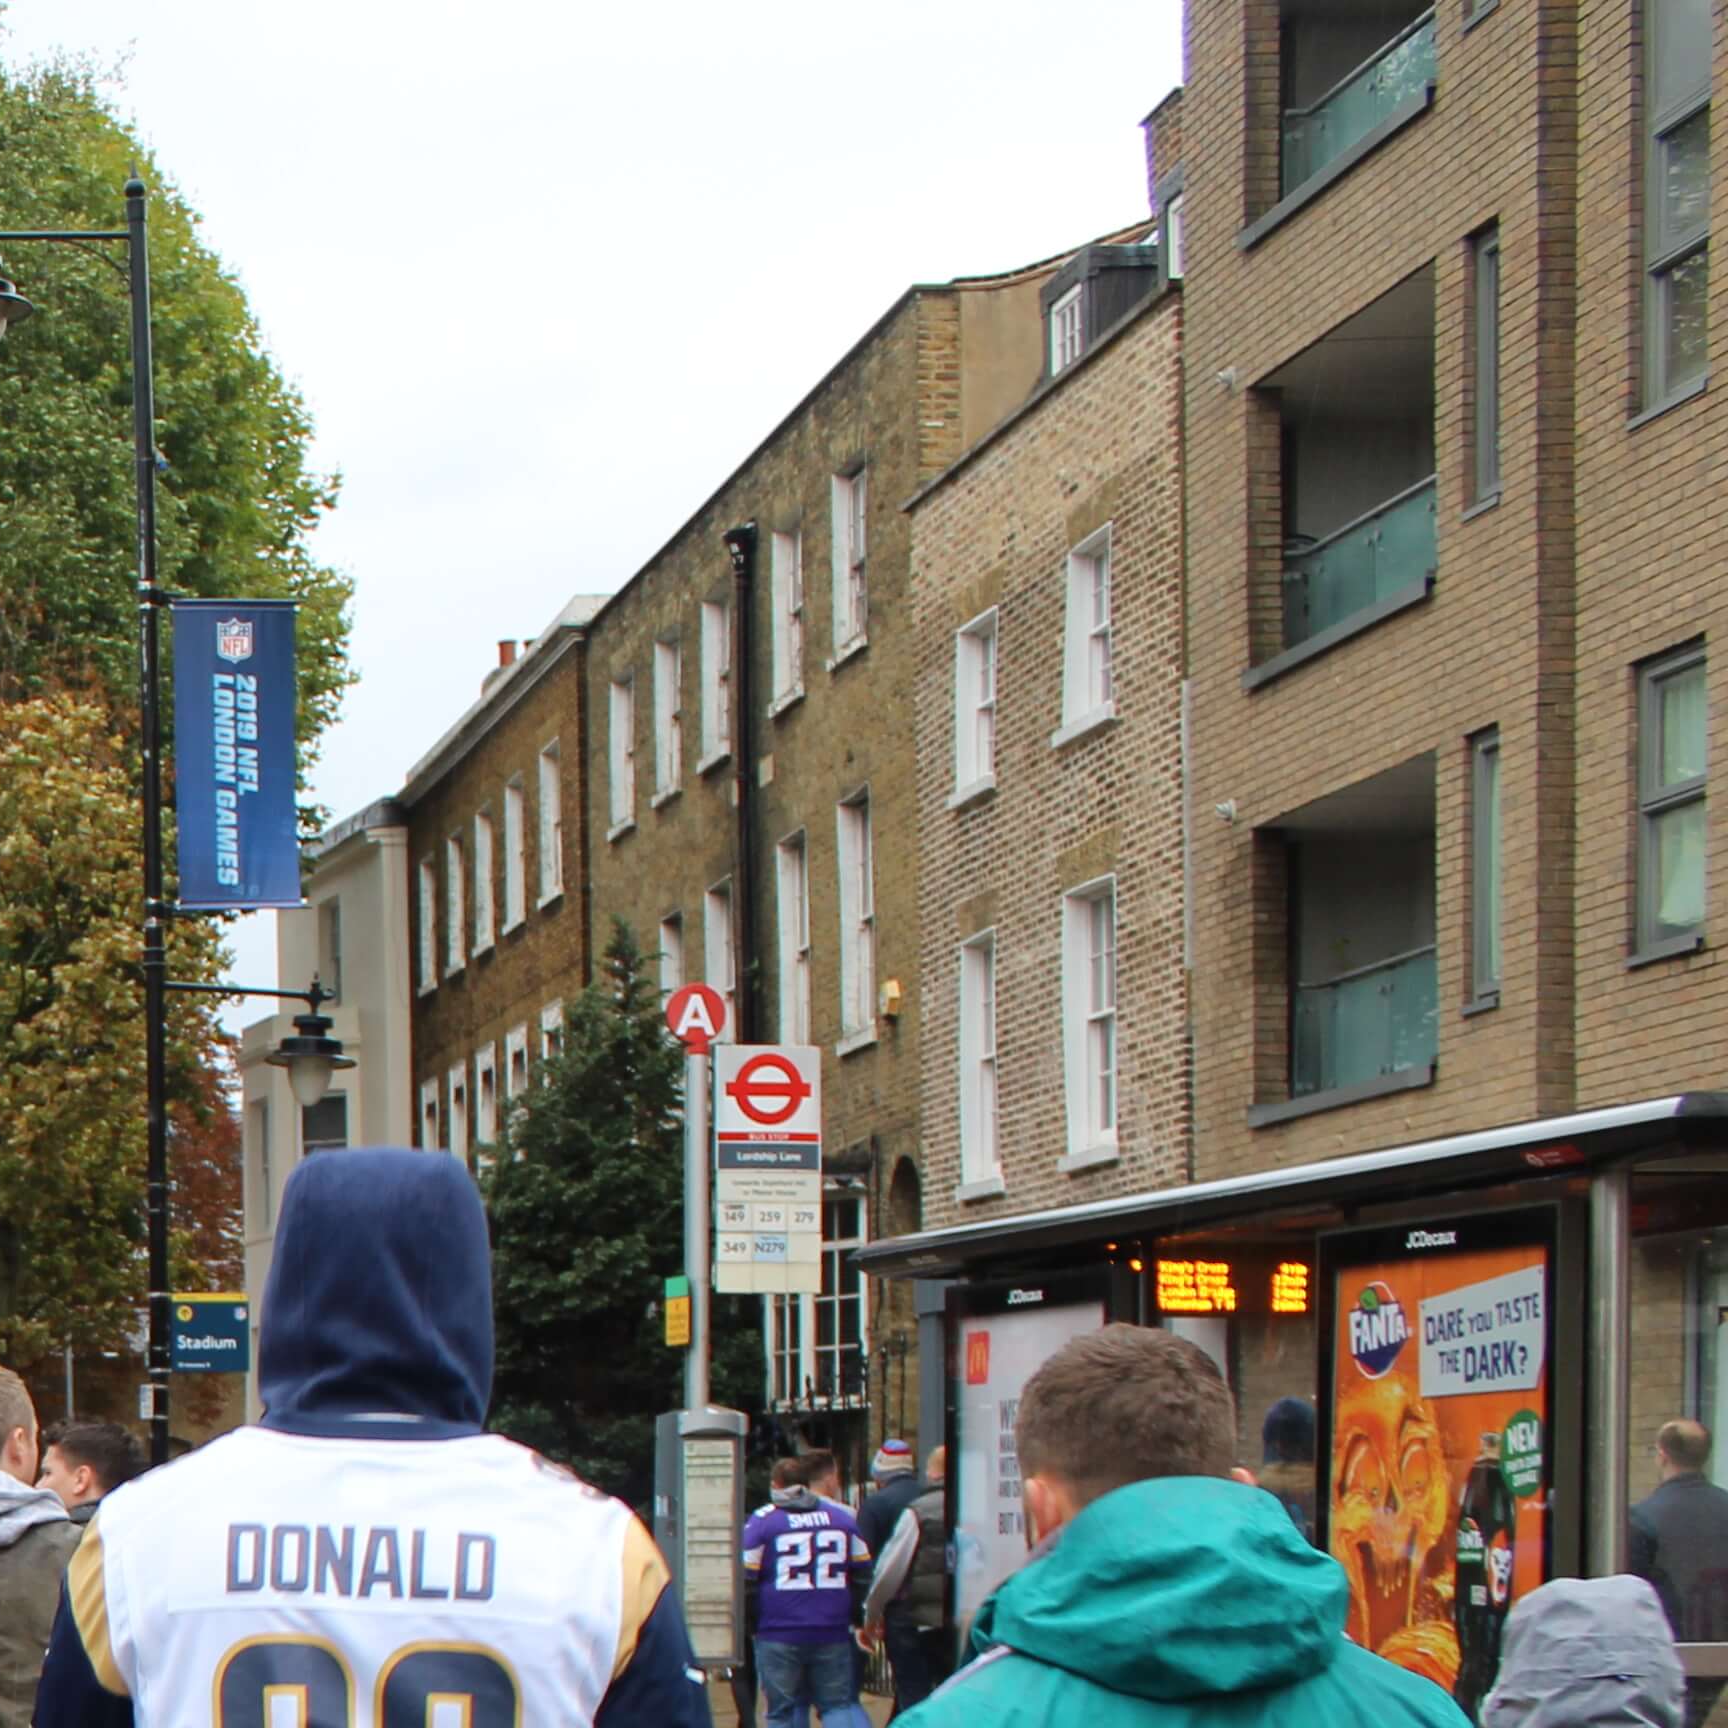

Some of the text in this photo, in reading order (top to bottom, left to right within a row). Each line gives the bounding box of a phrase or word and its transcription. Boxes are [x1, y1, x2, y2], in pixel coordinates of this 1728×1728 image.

[223, 637, 247, 653] NFL
[236, 674, 259, 796] 2019 NFL
[213, 674, 239, 886] LONDON GAMES
[676, 993, 714, 1036] A
[736, 1151, 801, 1163] Lordship Lane
[725, 1211, 814, 1223] 149 259 279
[723, 1241, 785, 1253] 349 N279
[1406, 1231, 1457, 1248] JCDecaux
[1349, 1303, 1407, 1355] FANTA
[1424, 1308, 1464, 1345] DARE
[1496, 1292, 1540, 1326] TASTE
[176, 1334, 237, 1350] Stadium
[1438, 1340, 1528, 1383] THE DARK?
[1506, 1419, 1539, 1455] NEW
[788, 1511, 830, 1529] SMITH
[225, 1522, 495, 1602] DONALD
[775, 1529, 847, 1591] 22
